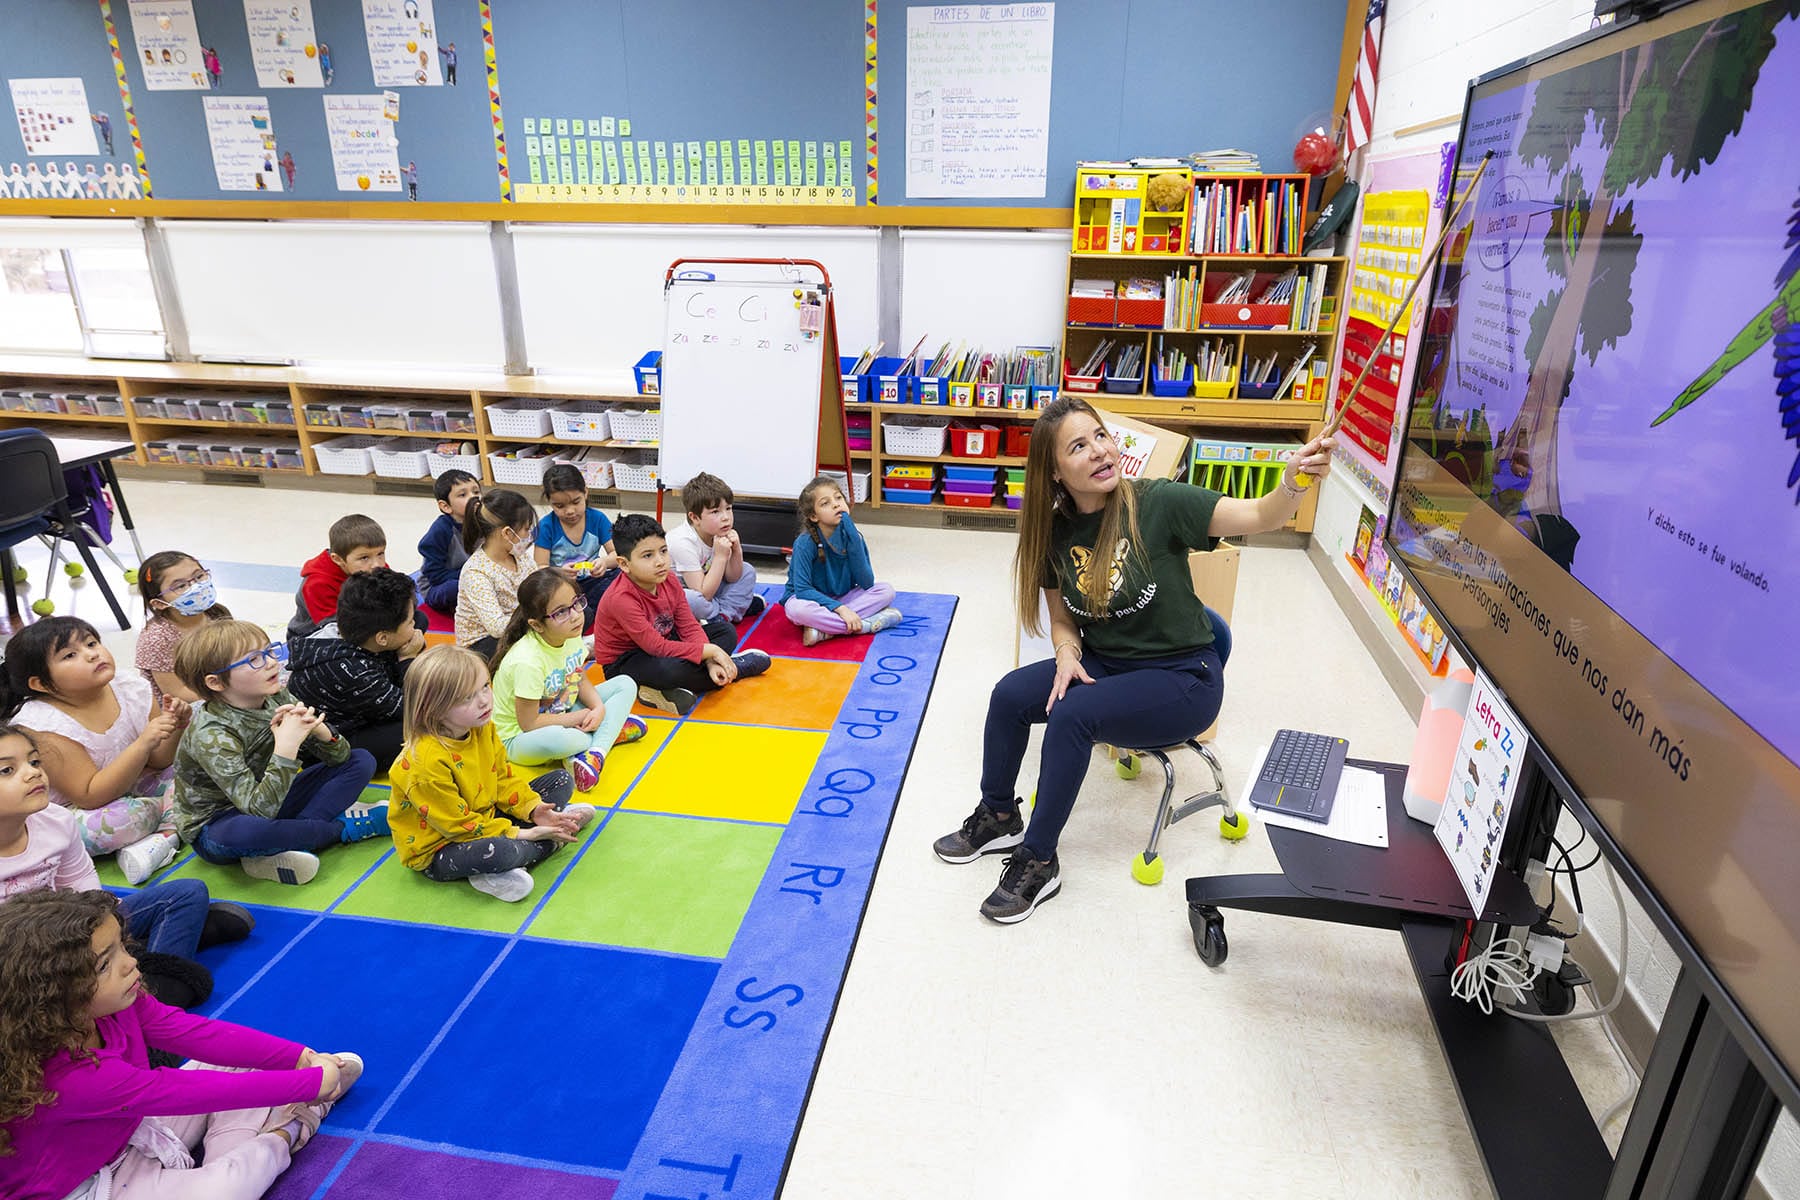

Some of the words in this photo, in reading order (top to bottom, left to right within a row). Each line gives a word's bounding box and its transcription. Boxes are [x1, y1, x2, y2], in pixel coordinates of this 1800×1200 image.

[934, 7, 969, 20] PARTES
[979, 7, 992, 20] DE
[1000, 7, 1014, 18] UN
[1022, 7, 1047, 18] LIBRO
[551, 187, 556, 195] 2
[566, 187, 572, 195] 3
[581, 187, 587, 195] 4
[597, 187, 603, 196] 5
[613, 187, 620, 196] 6
[630, 187, 636, 196] 7
[645, 187, 651, 196] 8
[661, 187, 668, 196] 9
[677, 187, 686, 197] 10
[694, 188, 701, 196] 11
[708, 188, 718, 197] 12
[725, 188, 735, 197] 13
[742, 188, 751, 197] 14
[758, 188, 767, 197] 15
[775, 188, 785, 197] 16
[792, 188, 801, 197] 17
[808, 188, 817, 197] 18
[826, 188, 835, 197] 19
[841, 188, 853, 198] 20
[686, 292, 718, 320] Ce
[738, 295, 768, 323] Ci
[885, 388, 897, 398] 10
[1647, 507, 1654, 520] Y
[1655, 513, 1675, 535] dicho
[1678, 530, 1695, 546] esto
[1698, 542, 1708, 554] se
[1711, 545, 1726, 565] fue
[1730, 560, 1770, 592] volando.
[1116, 608, 1137, 618] por
[1136, 582, 1157, 609] vida
[1451, 555, 1464, 580] los
[1462, 573, 1511, 634] personajes
[870, 655, 917, 686] Oo
[1462, 536, 1473, 559] en
[1474, 543, 1488, 571] las
[1488, 555, 1551, 637] ilustraciones
[1553, 629, 1579, 665] que
[1581, 657, 1608, 697] nos
[1612, 687, 1644, 736] dan
[1649, 726, 1691, 781] más
[840, 708, 899, 740] Pp
[1475, 690, 1501, 740] Letra
[1500, 727, 1514, 759] Zz
[799, 767, 876, 819] Qq
[779, 862, 845, 905] Rr
[723, 976, 804, 1033] Ss
